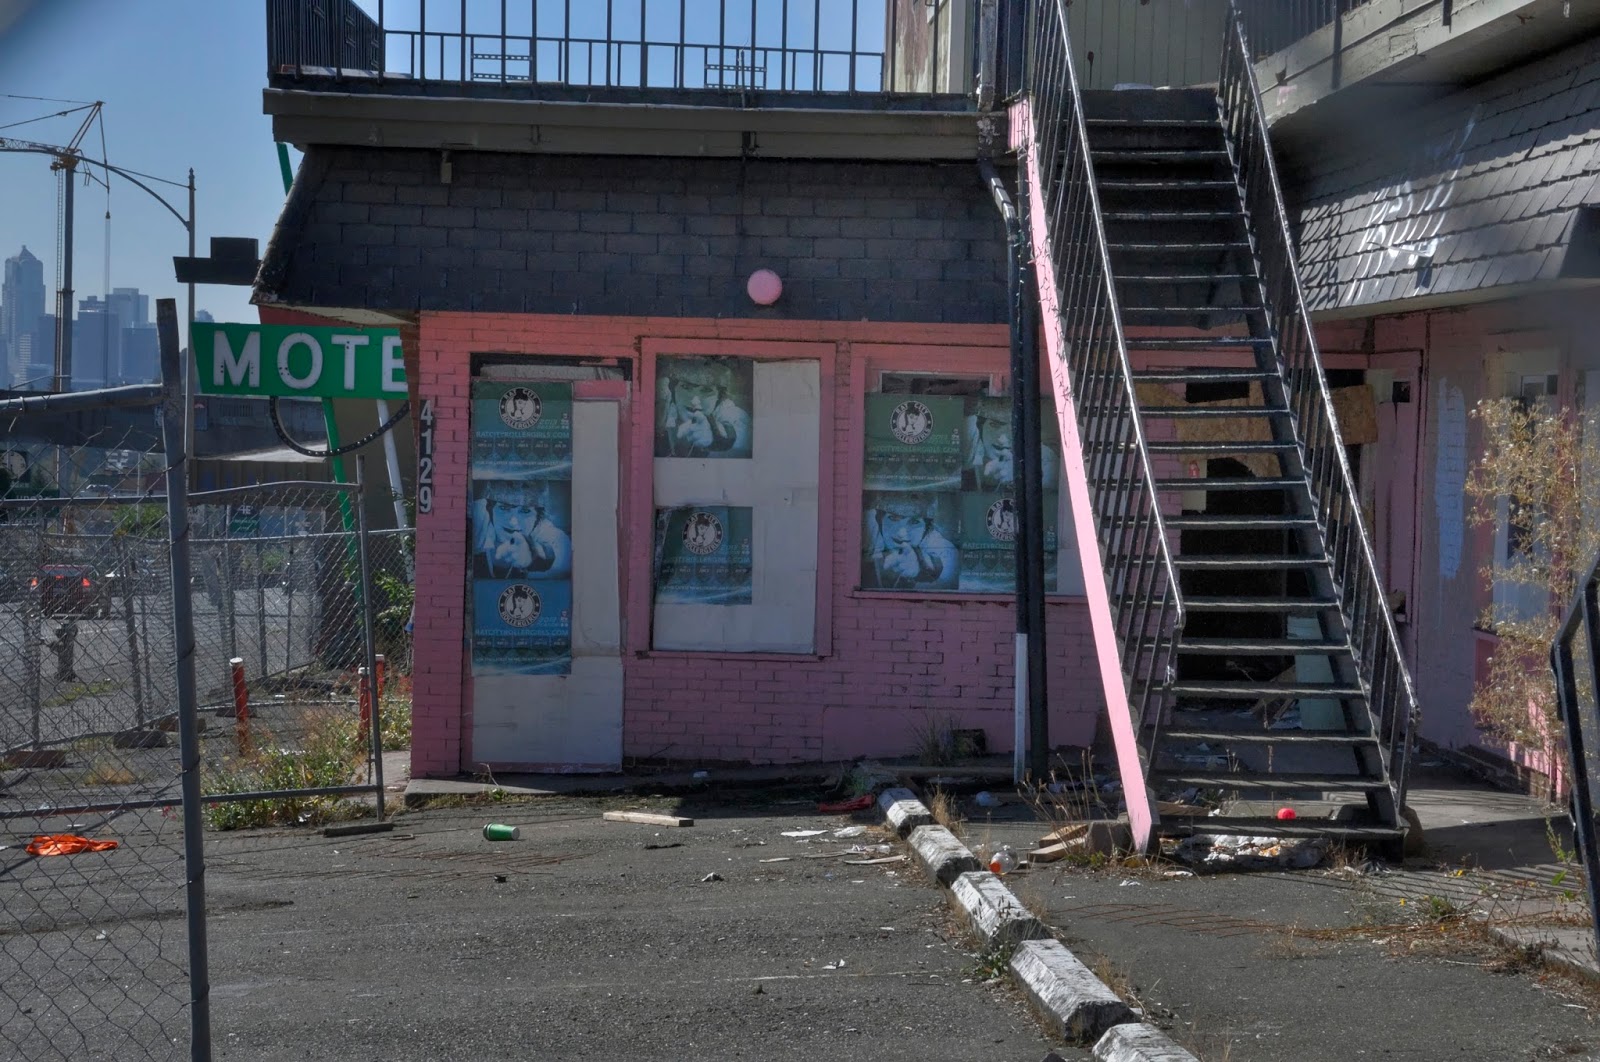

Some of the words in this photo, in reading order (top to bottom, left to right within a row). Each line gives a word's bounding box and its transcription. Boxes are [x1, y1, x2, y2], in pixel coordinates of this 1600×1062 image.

[213, 331, 408, 392] MOTE
[522, 389, 537, 399] CITY
[914, 403, 929, 414] CITY
[420, 399, 433, 513] 4129
[521, 586, 537, 597] CITY
